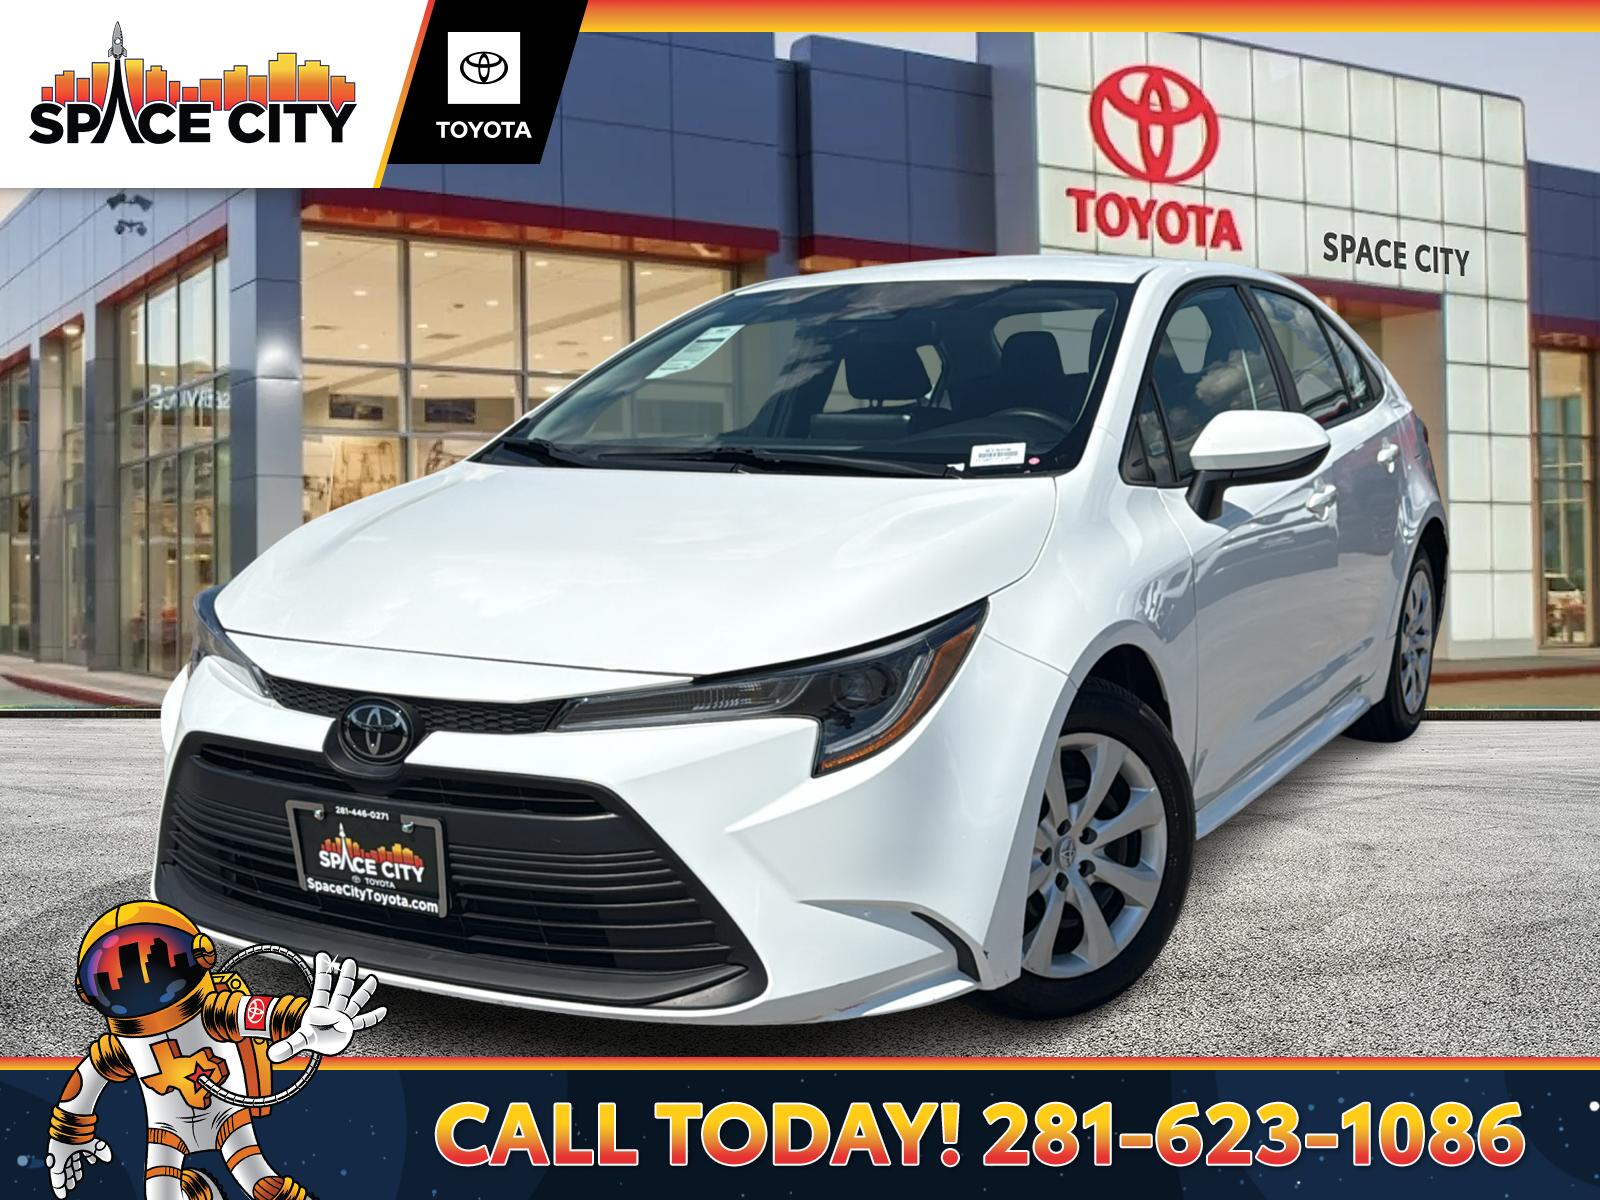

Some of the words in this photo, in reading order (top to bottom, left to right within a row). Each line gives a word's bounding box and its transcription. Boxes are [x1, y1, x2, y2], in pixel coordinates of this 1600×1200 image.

[1066, 187, 1243, 252] TOYOTA
[1323, 231, 1407, 270] SPACE
[1414, 244, 1471, 277] CITY
[335, 805, 390, 821] 281-446-0271
[318, 846, 379, 876] SPACE
[381, 860, 425, 883] CITY
[364, 877, 396, 889] TOYOTA
[306, 876, 439, 914] SpaceCityToyota.com
